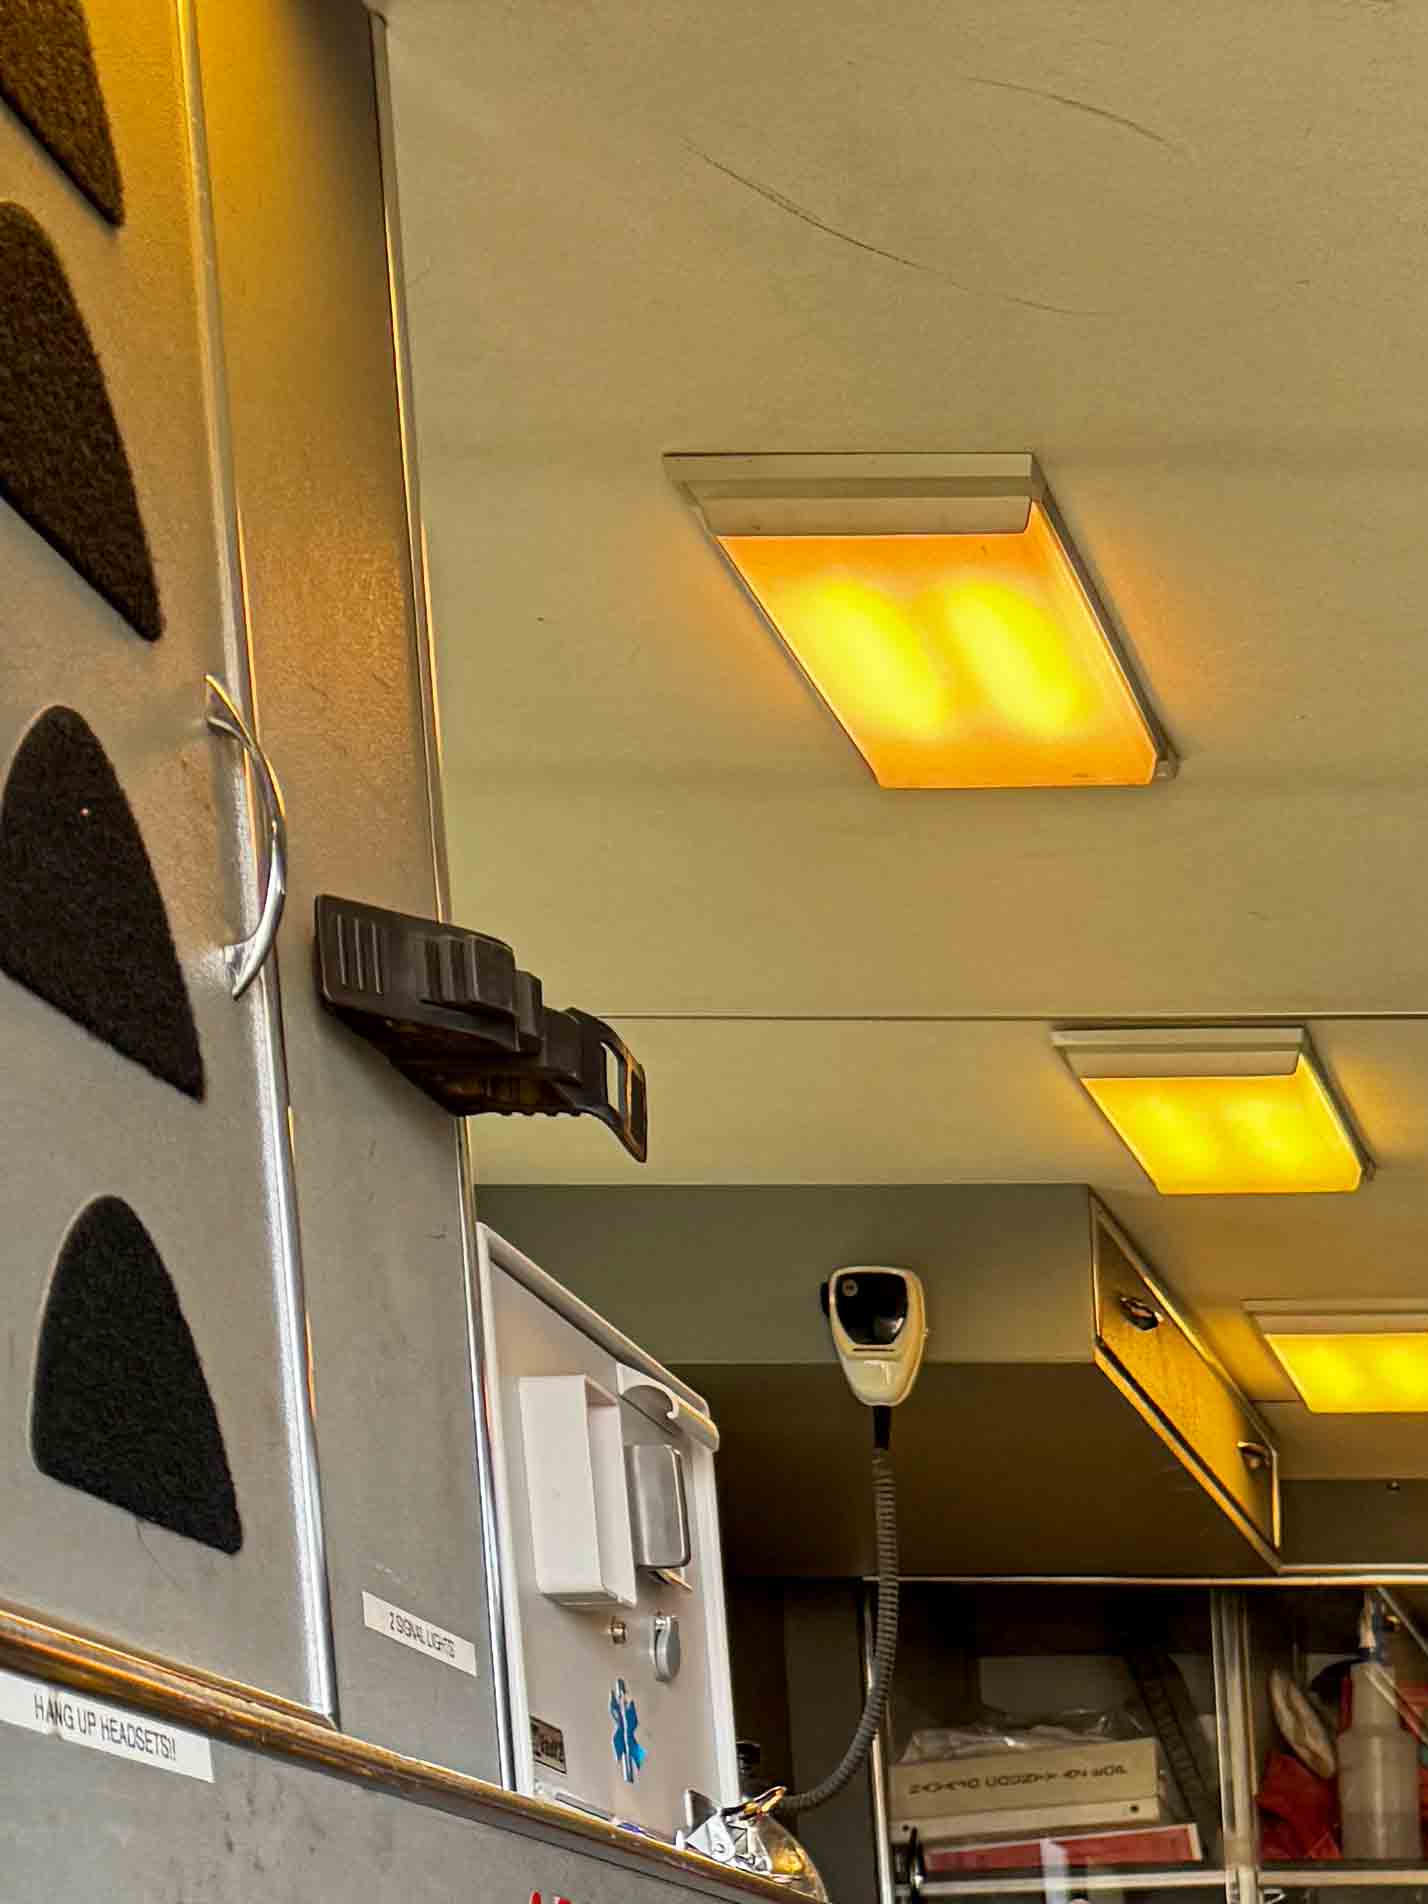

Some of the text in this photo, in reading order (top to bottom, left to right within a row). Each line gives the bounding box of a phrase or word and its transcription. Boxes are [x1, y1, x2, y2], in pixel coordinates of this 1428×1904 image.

[33, 1693, 177, 1760] HANG UP HEADSETS!!
